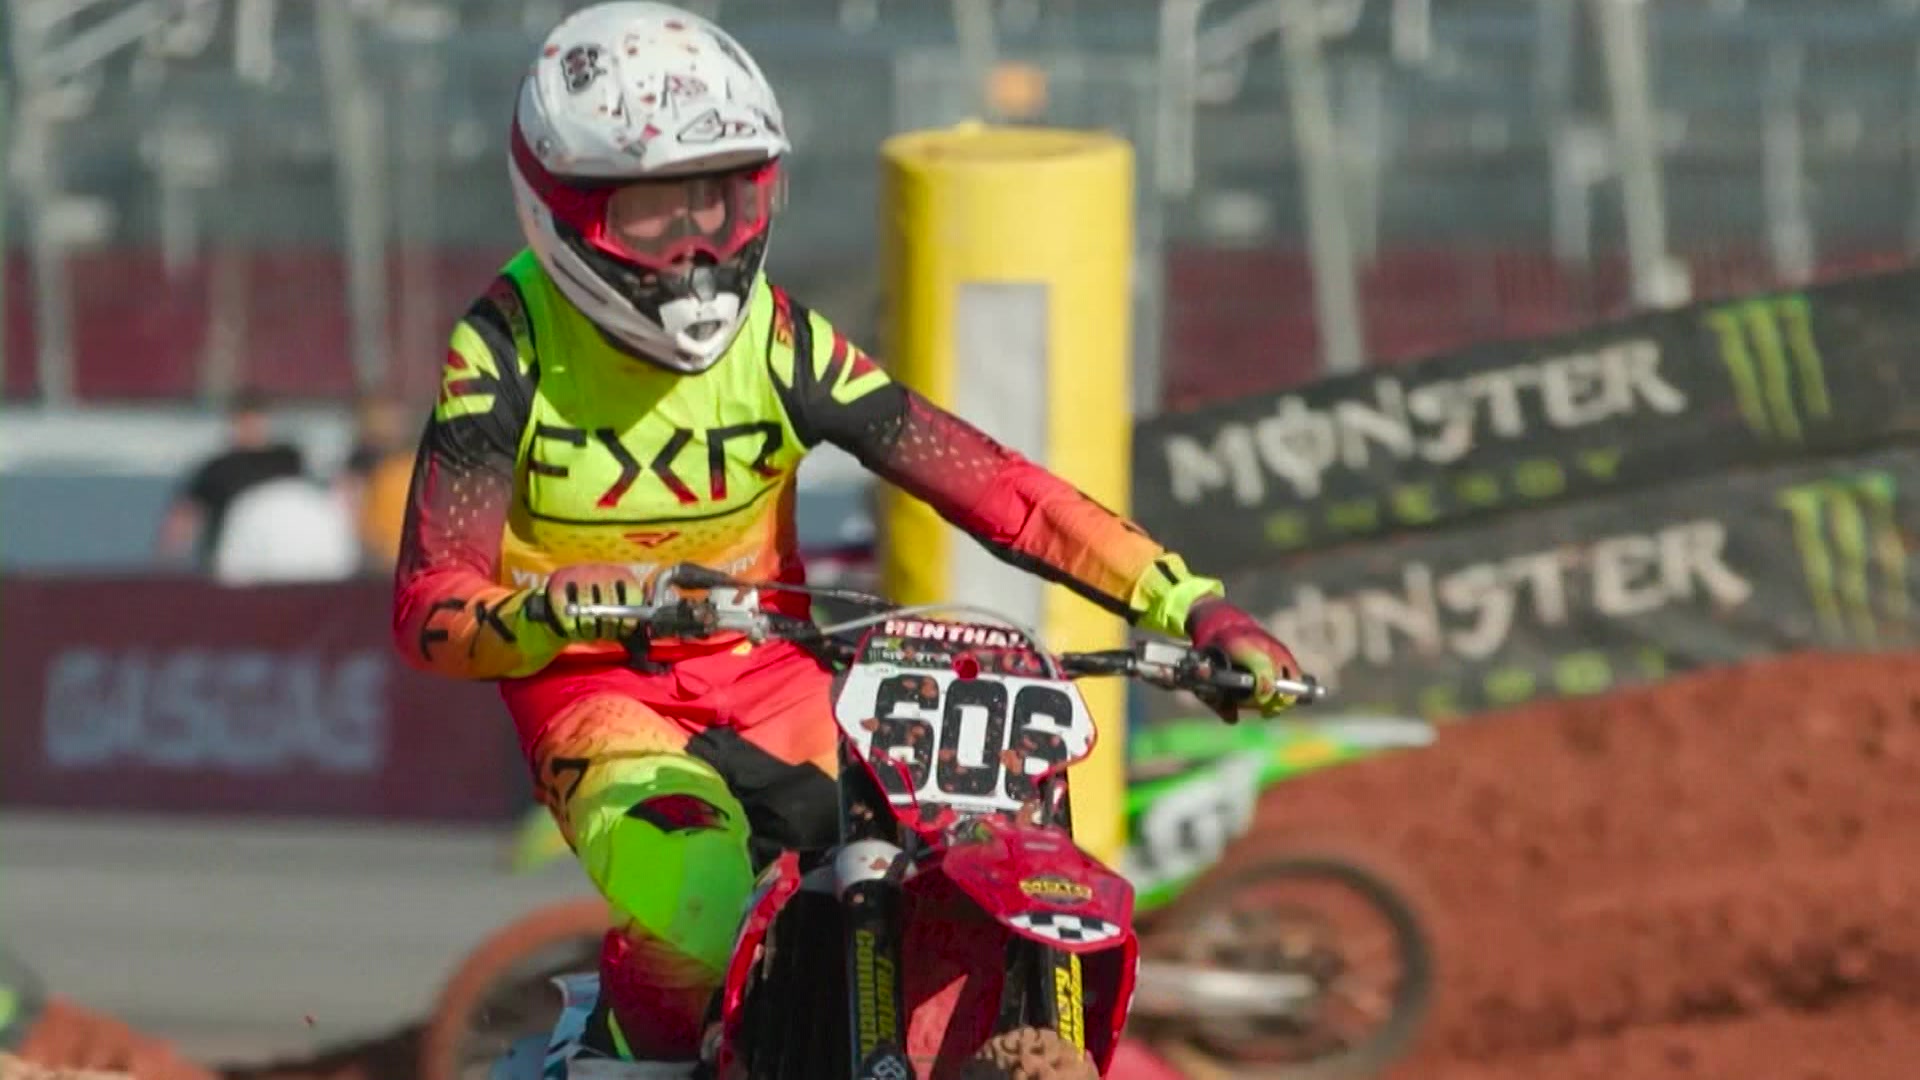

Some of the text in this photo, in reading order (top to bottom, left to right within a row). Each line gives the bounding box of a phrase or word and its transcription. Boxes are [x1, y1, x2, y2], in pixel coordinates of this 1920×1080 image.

[527, 421, 784, 508] FXR
[1165, 338, 1687, 505] MONSTER
[1270, 519, 1753, 696] ONSTER
[869, 673, 1073, 802] 606
